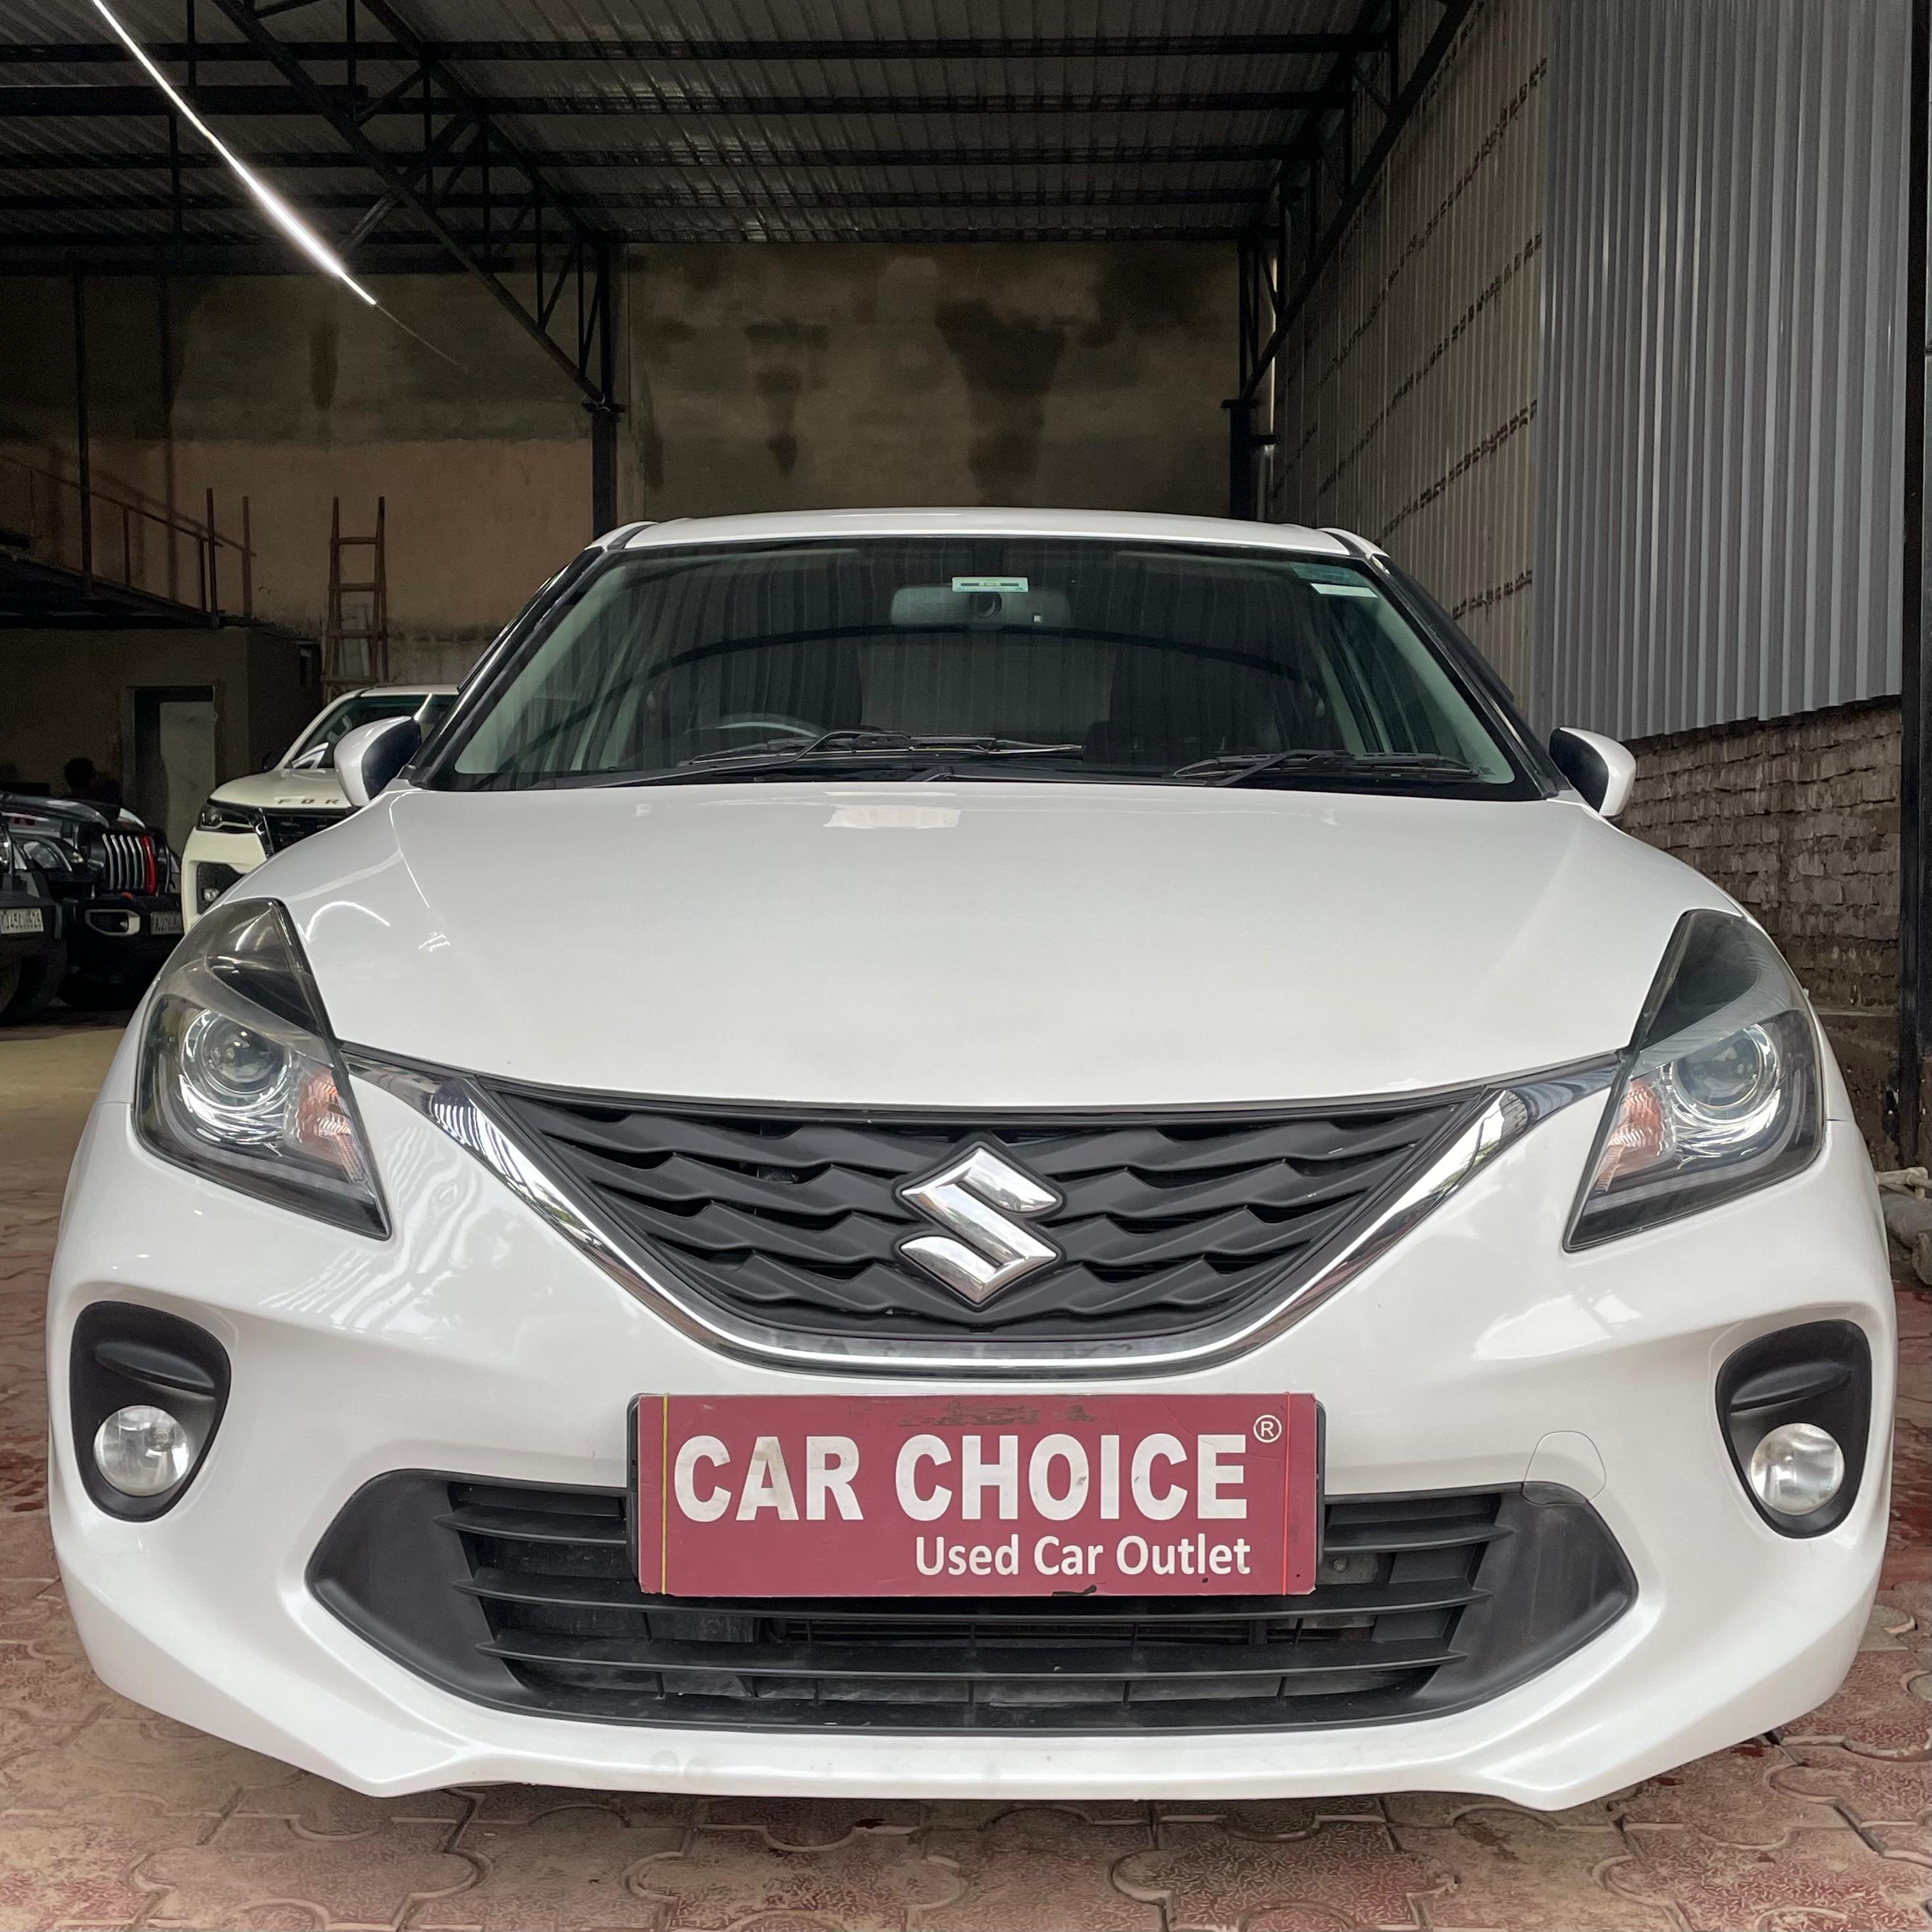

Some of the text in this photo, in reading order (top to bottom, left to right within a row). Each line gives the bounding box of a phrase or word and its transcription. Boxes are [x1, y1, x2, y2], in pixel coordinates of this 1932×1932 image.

[674, 1434, 864, 1523] CAR
[895, 1433, 1247, 1521] CHOICE
[916, 1532, 1251, 1576] Used Car Outlet
